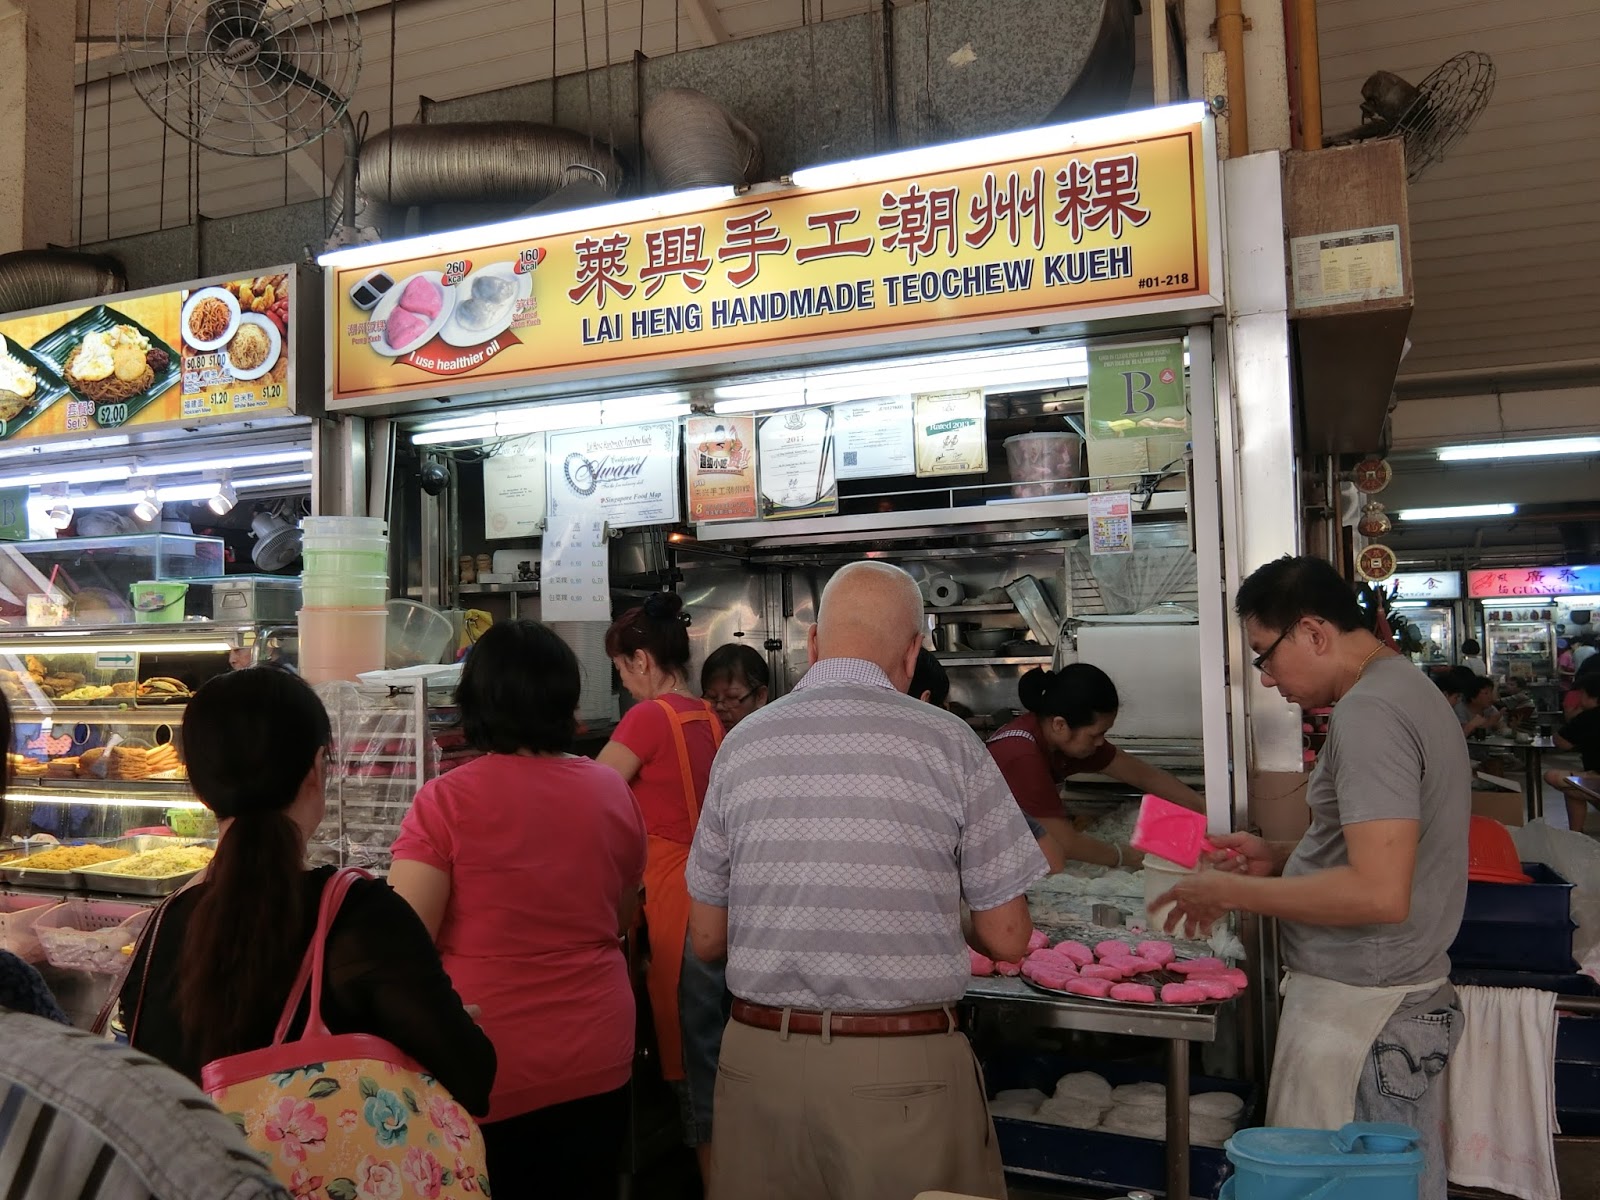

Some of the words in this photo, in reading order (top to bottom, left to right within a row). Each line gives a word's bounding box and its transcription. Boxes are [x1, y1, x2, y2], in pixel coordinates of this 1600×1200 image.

[567, 153, 1150, 310] 萊興手工潮州粿
[520, 248, 539, 262] 160
[446, 260, 465, 275] 260
[520, 262, 538, 272] kcal
[447, 275, 464, 284] kcal
[1138, 273, 1189, 290] #01-218
[582, 313, 623, 345] LAI
[631, 302, 702, 339] HENG
[711, 279, 875, 329] HANDMADE
[882, 255, 1035, 307] TEOCHEW
[1044, 246, 1133, 288] KUEH
[187, 355, 206, 370] $0.80
[209, 353, 226, 367] $1.00
[409, 351, 417, 362] I
[416, 357, 434, 369] use
[437, 351, 484, 371] healthier
[487, 339, 501, 356] oil
[210, 391, 228, 405] $1.20
[263, 384, 281, 398] $1.20
[1119, 371, 1156, 416] B
[101, 405, 125, 423] $2.00
[67, 418, 80, 430] Set
[82, 416, 88, 428] 3
[575, 454, 648, 482] Award
[633, 492, 648, 500] Food
[695, 503, 703, 515] 8
[1512, 585, 1562, 595] GUANG
